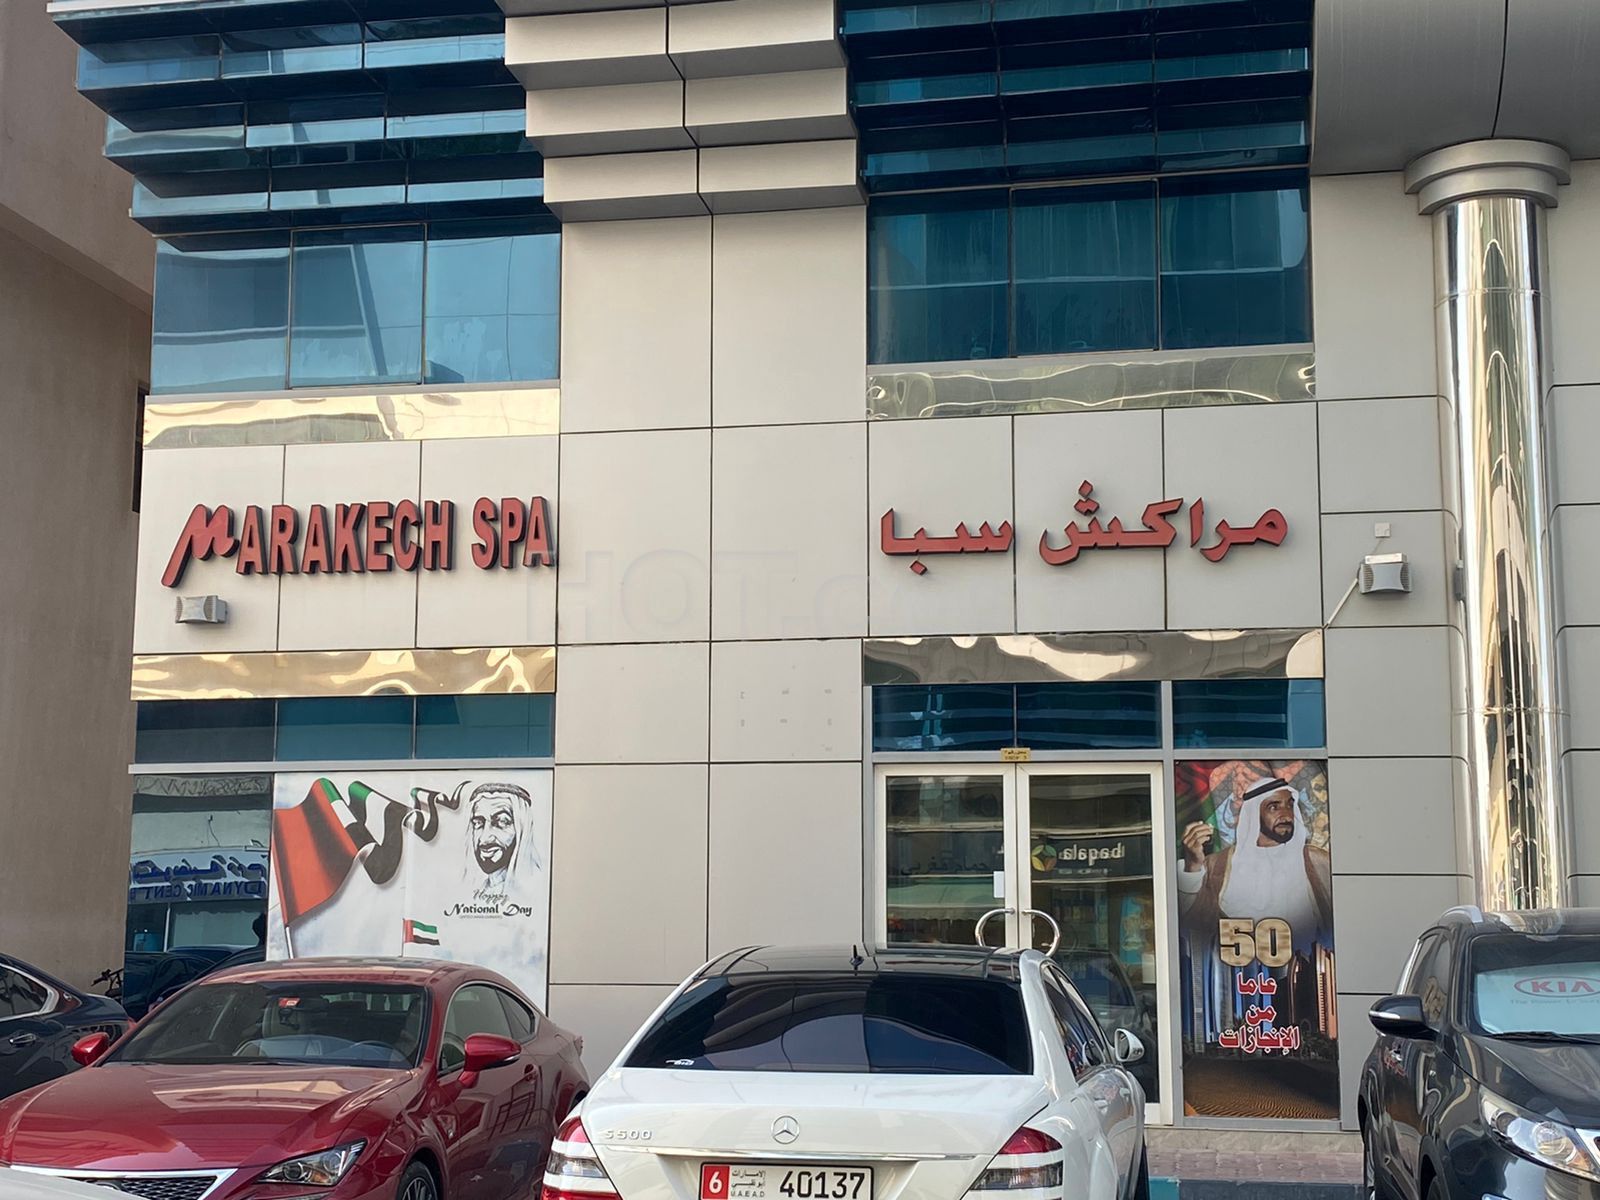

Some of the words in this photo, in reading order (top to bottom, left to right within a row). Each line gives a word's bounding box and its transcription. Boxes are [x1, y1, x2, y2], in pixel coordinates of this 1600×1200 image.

[1038, 479, 1289, 566] مراكش
[160, 499, 455, 588] MARAKECH
[470, 495, 555, 570] SPA
[880, 507, 1014, 576] سبا
[444, 903, 499, 917] National
[503, 903, 533, 917] Day
[1218, 917, 1293, 968] 50
[1236, 972, 1278, 996] عاما
[1531, 981, 1595, 993] KIA
[1245, 1004, 1278, 1026] من
[708, 1171, 723, 1194] 6
[779, 1170, 866, 1200] 40137
